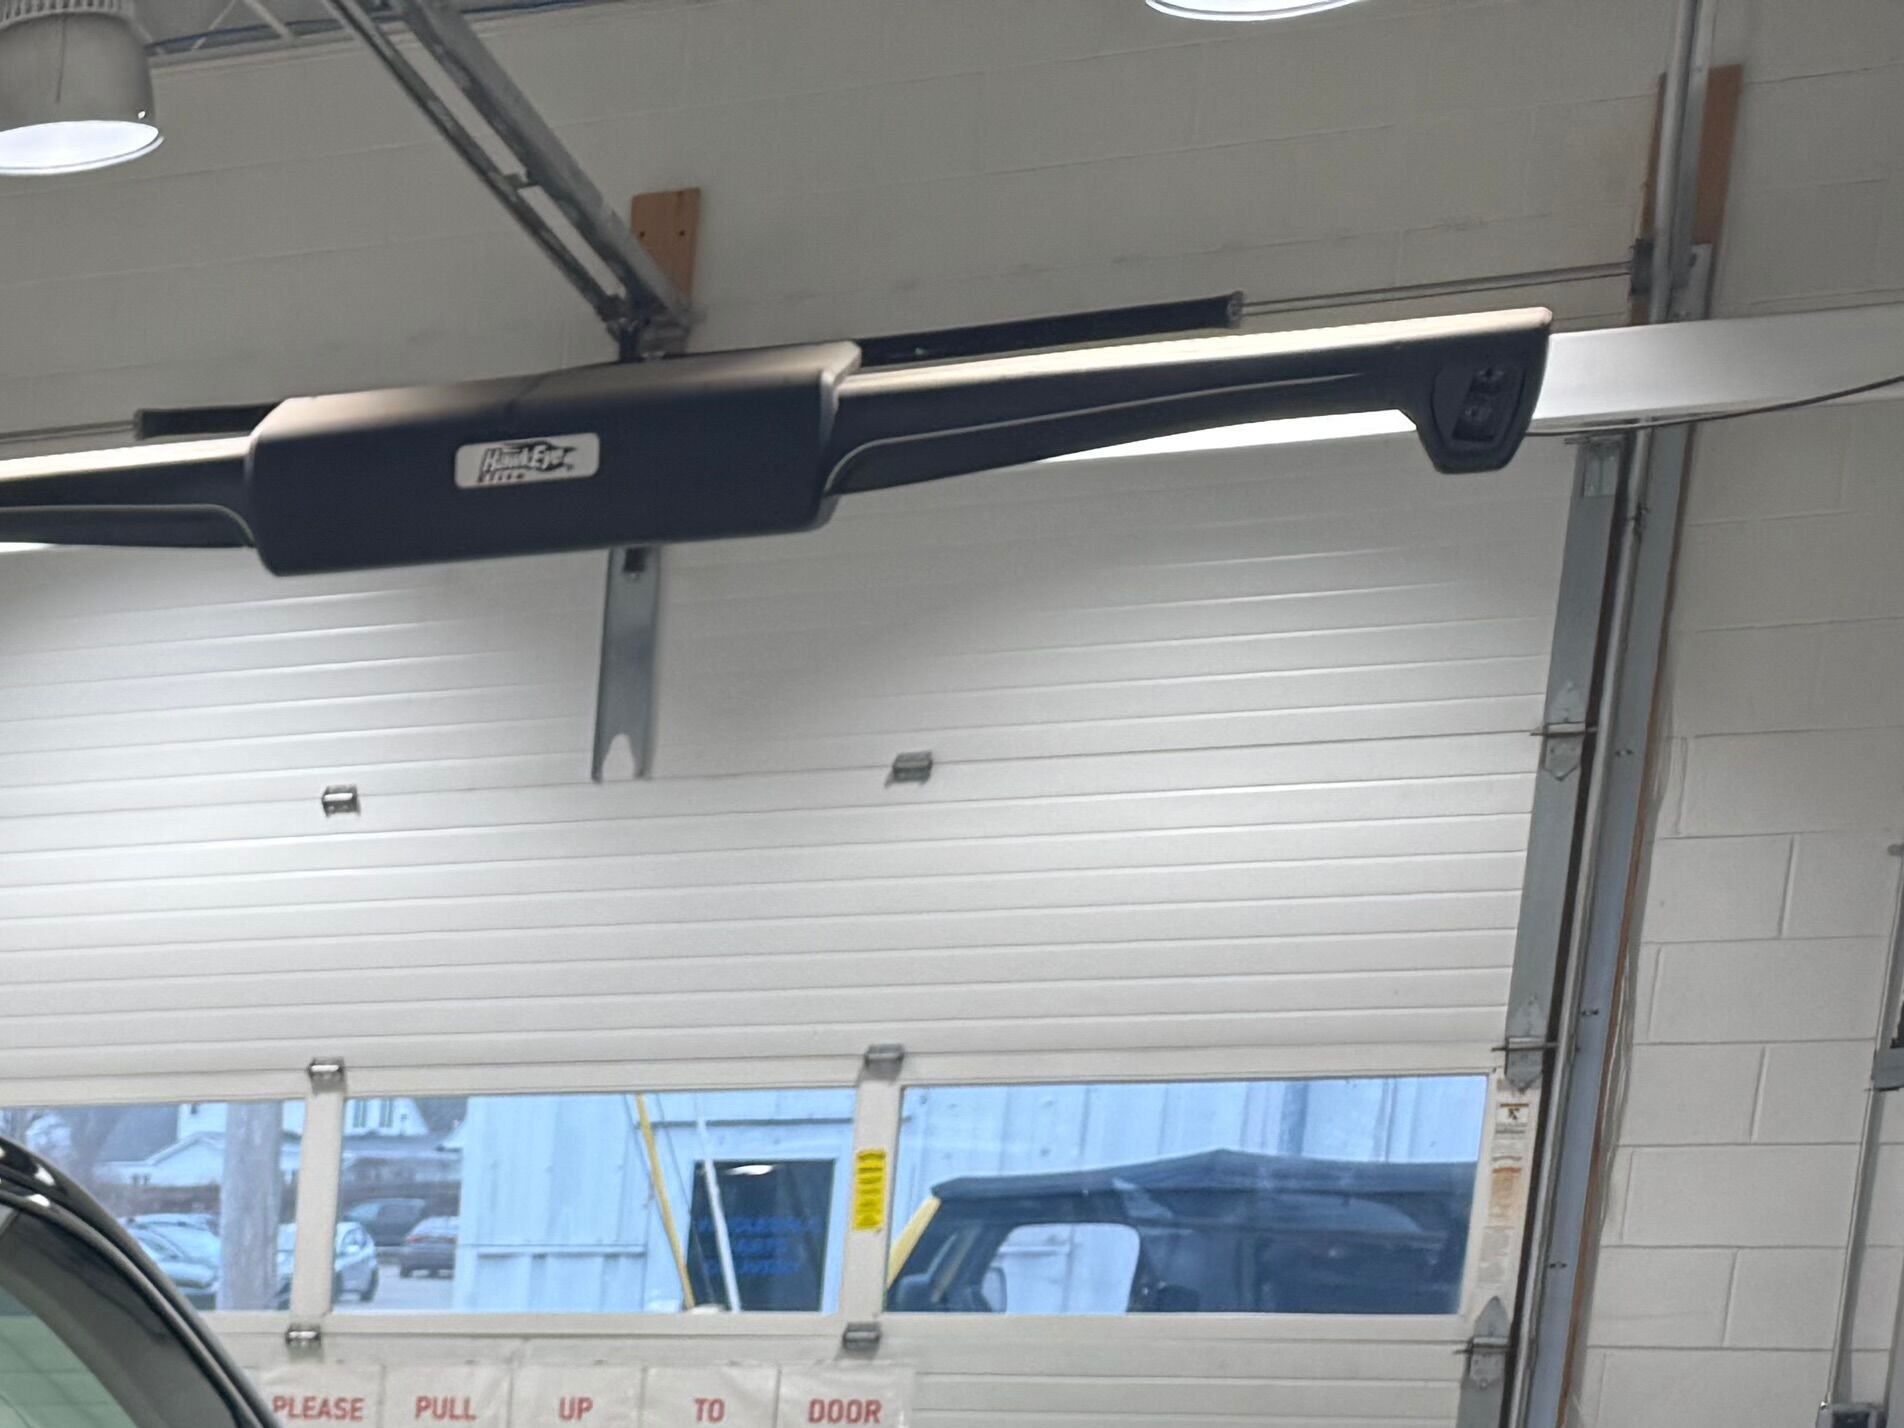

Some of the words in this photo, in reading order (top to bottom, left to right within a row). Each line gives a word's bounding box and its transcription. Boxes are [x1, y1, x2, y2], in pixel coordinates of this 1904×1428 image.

[272, 1395, 364, 1421] PLEASE
[415, 1396, 477, 1421] PULL
[559, 1396, 593, 1422] UP
[694, 1398, 725, 1423] TO
[807, 1398, 882, 1424] DOOR
